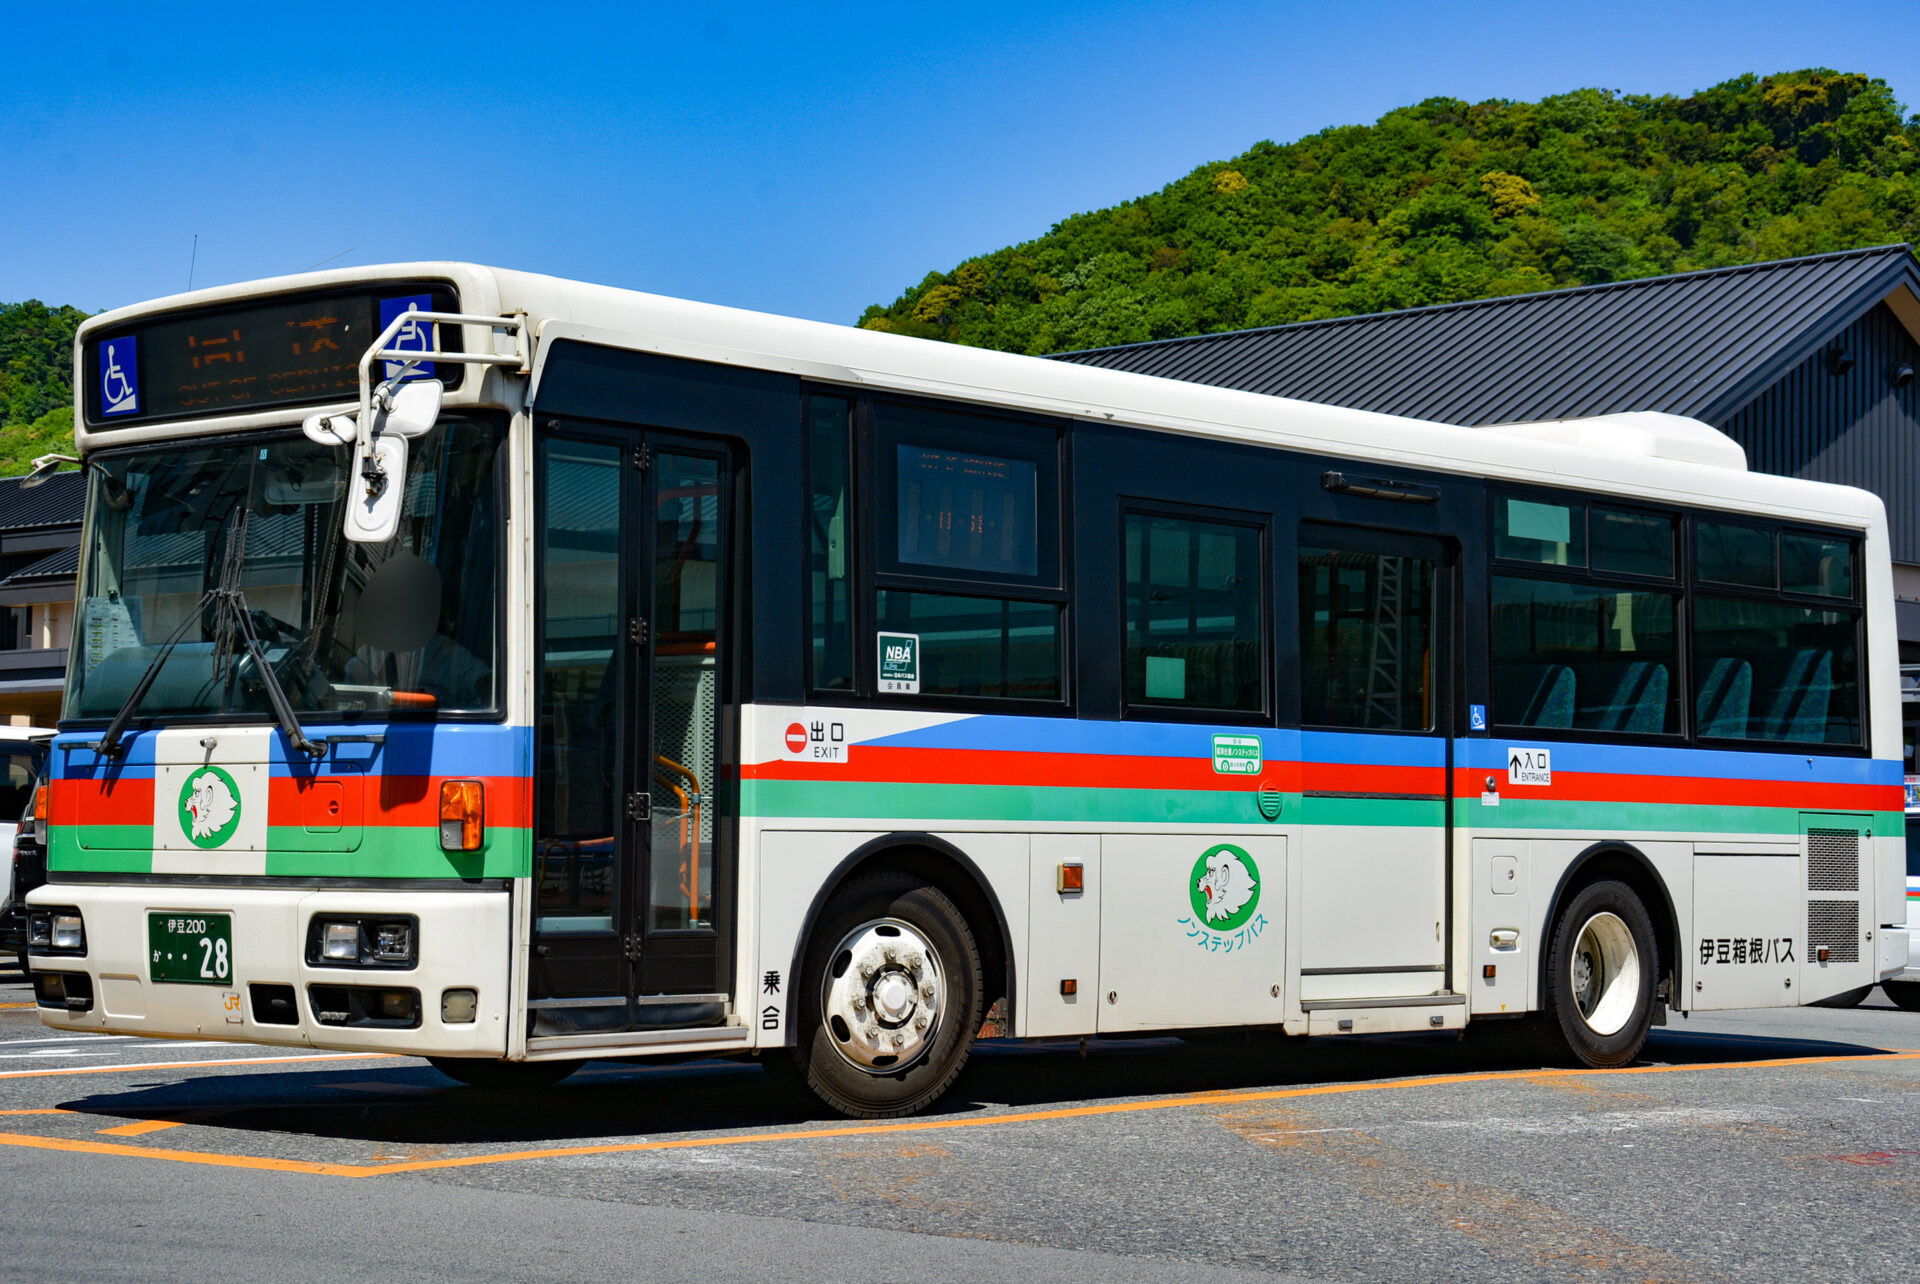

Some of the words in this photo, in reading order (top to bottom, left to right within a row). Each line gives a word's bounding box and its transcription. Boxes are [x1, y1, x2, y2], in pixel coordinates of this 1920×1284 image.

[886, 645, 911, 660] NBA
[810, 720, 843, 742] 出口
[814, 746, 839, 758] EXIT
[1525, 752, 1546, 769] 入口
[1521, 772, 1549, 782] ENTRANCE
[1177, 914, 1268, 953] ノンステップバス
[1700, 937, 1795, 965] 伊豆箱根バス
[224, 996, 240, 1011] JR
[762, 971, 780, 1030] 乗合
